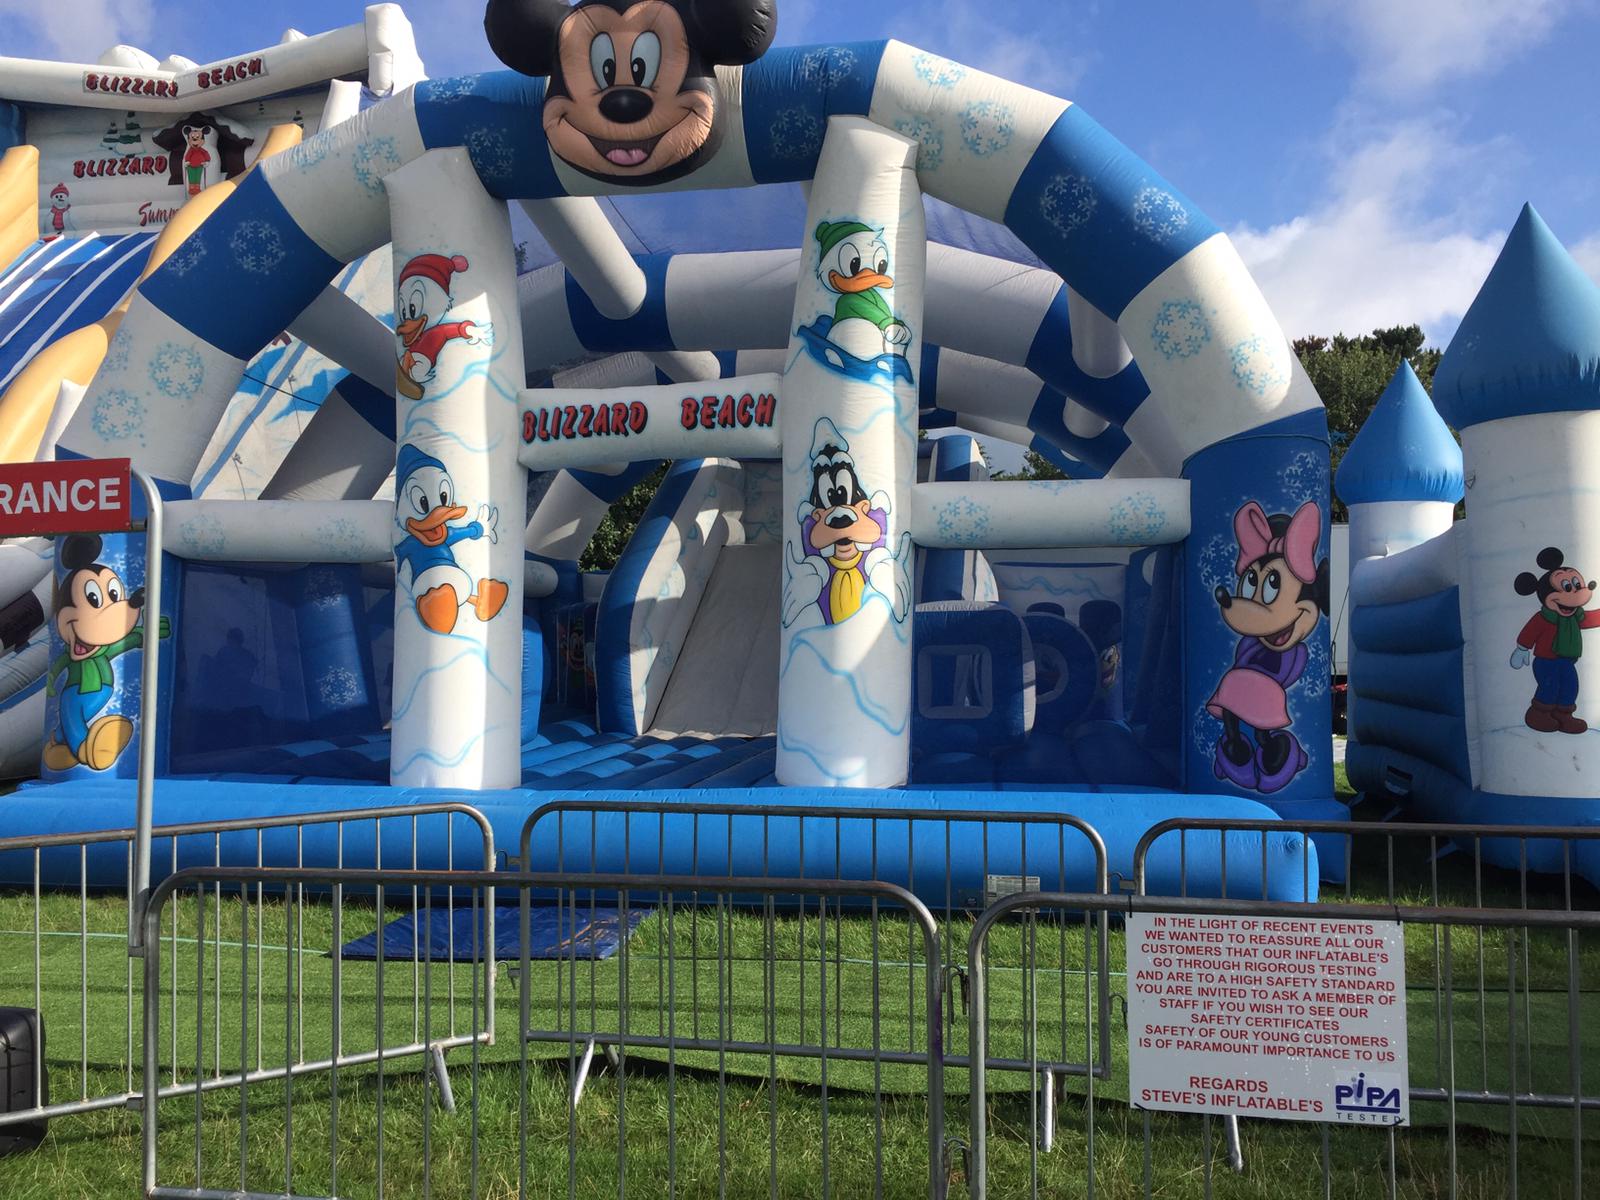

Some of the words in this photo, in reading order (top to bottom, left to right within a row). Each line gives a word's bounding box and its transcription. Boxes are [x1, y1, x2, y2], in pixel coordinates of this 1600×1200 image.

[197, 58, 262, 88] BEACH
[73, 156, 168, 178] BLIZZARD
[522, 401, 648, 443] BLIZZARD
[681, 393, 777, 431] BEACH
[1154, 917, 1166, 927] IN
[1170, 918, 1195, 928] THE
[1200, 919, 1237, 930] LIGHT
[1241, 920, 1259, 930] OF
[1263, 921, 1316, 933] RECENT
[1321, 923, 1373, 935] EVENTS
[1145, 930, 1165, 940] WE
[1169, 931, 1223, 944] WANTED
[1228, 933, 1245, 944] TO
[1249, 934, 1321, 947] REASSURE
[1325, 937, 1350, 948] ALL
[1354, 938, 1384, 948] OUR
[1141, 943, 1221, 956] CUSTOMERS
[1226, 947, 1259, 957] THAT
[1263, 948, 1292, 959] OUR
[1295, 950, 1389, 963] INFLATABLE'S
[1153, 957, 1172, 967] GO
[1176, 958, 1241, 971] THROUGH
[1244, 961, 1316, 974] RIGOROUS
[1320, 964, 1377, 977] TESTING
[1136, 970, 1163, 980] AND
[1167, 971, 1193, 982] ARE
[1197, 973, 1214, 983] TO
[1217, 974, 1227, 984] A
[1230, 974, 1263, 985] HIGH
[1266, 976, 1317, 988] SAFETY
[1321, 979, 1395, 992] STANDARD
[1136, 983, 1162, 994] YOU
[1166, 985, 1192, 995] ARE
[1197, 986, 1247, 999] INVITED
[1251, 989, 1269, 999] TO
[1272, 990, 1299, 1000] ASK
[1302, 992, 1312, 1001] A
[1315, 992, 1374, 1005] MEMBER
[1378, 995, 1397, 1005] OF
[1159, 998, 1199, 1009] STAFF
[1203, 1000, 1214, 1010] IF
[1218, 1001, 1245, 1012] YOU
[1249, 1003, 1283, 1014] WISH
[1287, 1004, 1305, 1015] TO
[1309, 1006, 1335, 1016] SEE
[1339, 1007, 1368, 1018] OUR
[1191, 1013, 1241, 1026] SAFETY
[1245, 1016, 1340, 1031] CERTIFICATES
[1145, 1024, 1195, 1037] SAFETY
[1198, 1028, 1216, 1037] OF
[1220, 1028, 1249, 1039] OUR
[1252, 1030, 1300, 1043] YOUNG
[1304, 1033, 1389, 1048] CUSTOMERS
[1139, 1037, 1151, 1047] IS
[1155, 1038, 1172, 1048] OF
[1176, 1039, 1259, 1055] PARAMOUNT
[1263, 1045, 1350, 1060] IMPORTANCE
[1354, 1050, 1372, 1060] TO
[1377, 1051, 1395, 1061] US
[1189, 1076, 1268, 1093] REGARDS
[1141, 1089, 1206, 1105] STEVE'S
[1211, 1093, 1323, 1112] INFLATABLE'S
